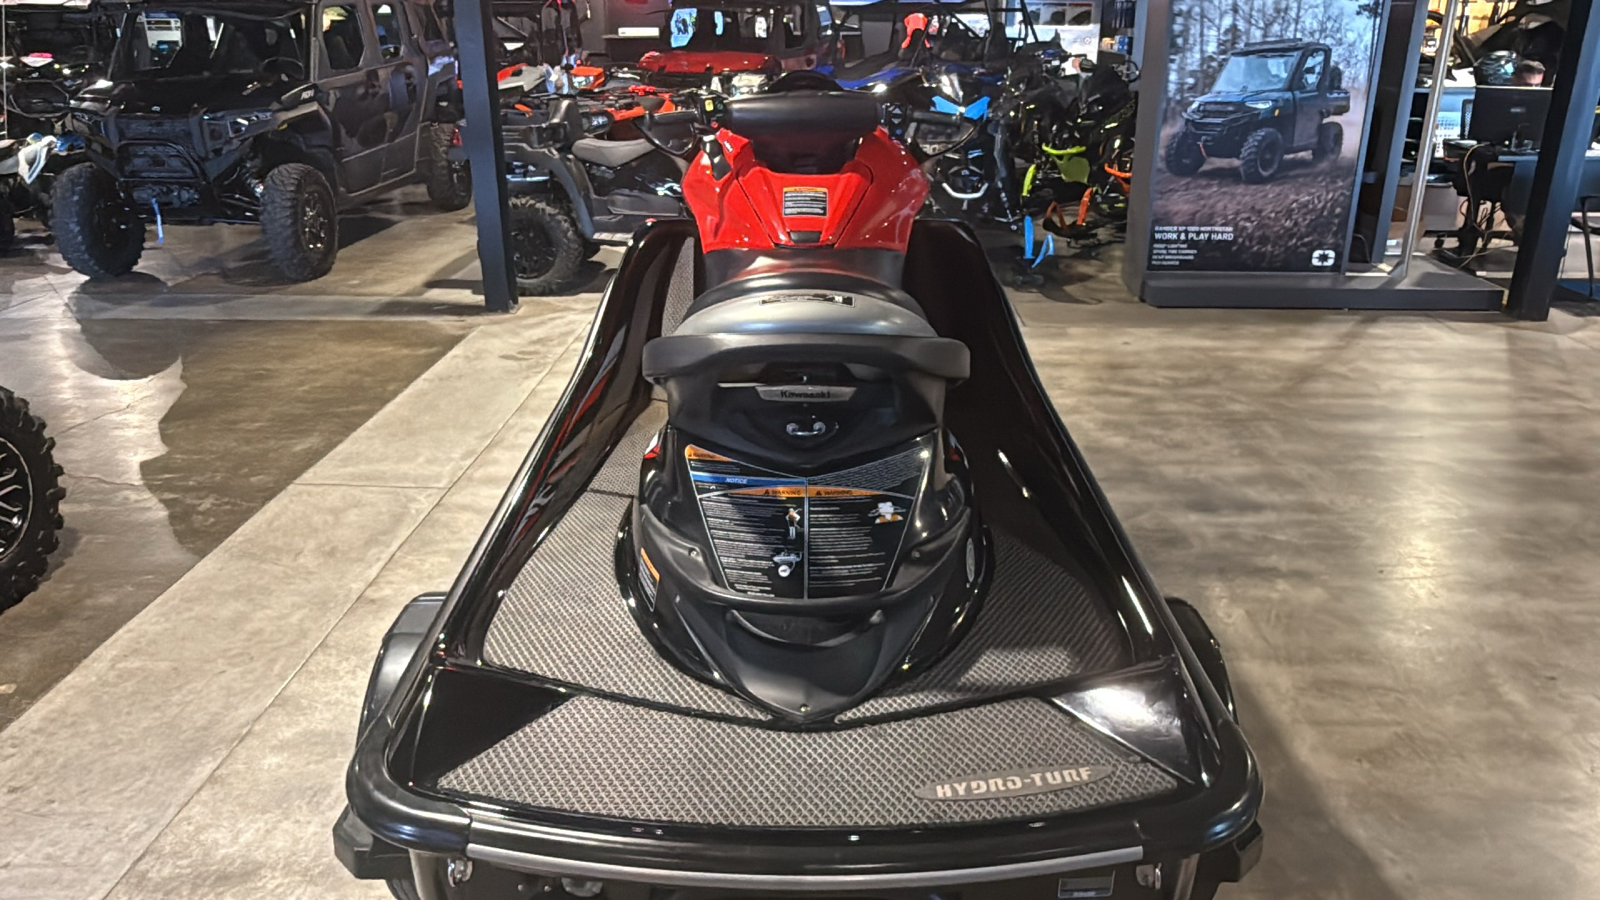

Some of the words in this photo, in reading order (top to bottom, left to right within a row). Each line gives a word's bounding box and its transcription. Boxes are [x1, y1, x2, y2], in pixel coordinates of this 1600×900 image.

[1154, 232, 1178, 240] WORK
[1180, 232, 1186, 240] &
[1188, 232, 1209, 240] PLAY
[1211, 232, 1234, 240] HARD
[725, 477, 748, 485] NOTICE
[936, 766, 1093, 799] HYDRO-TURF
